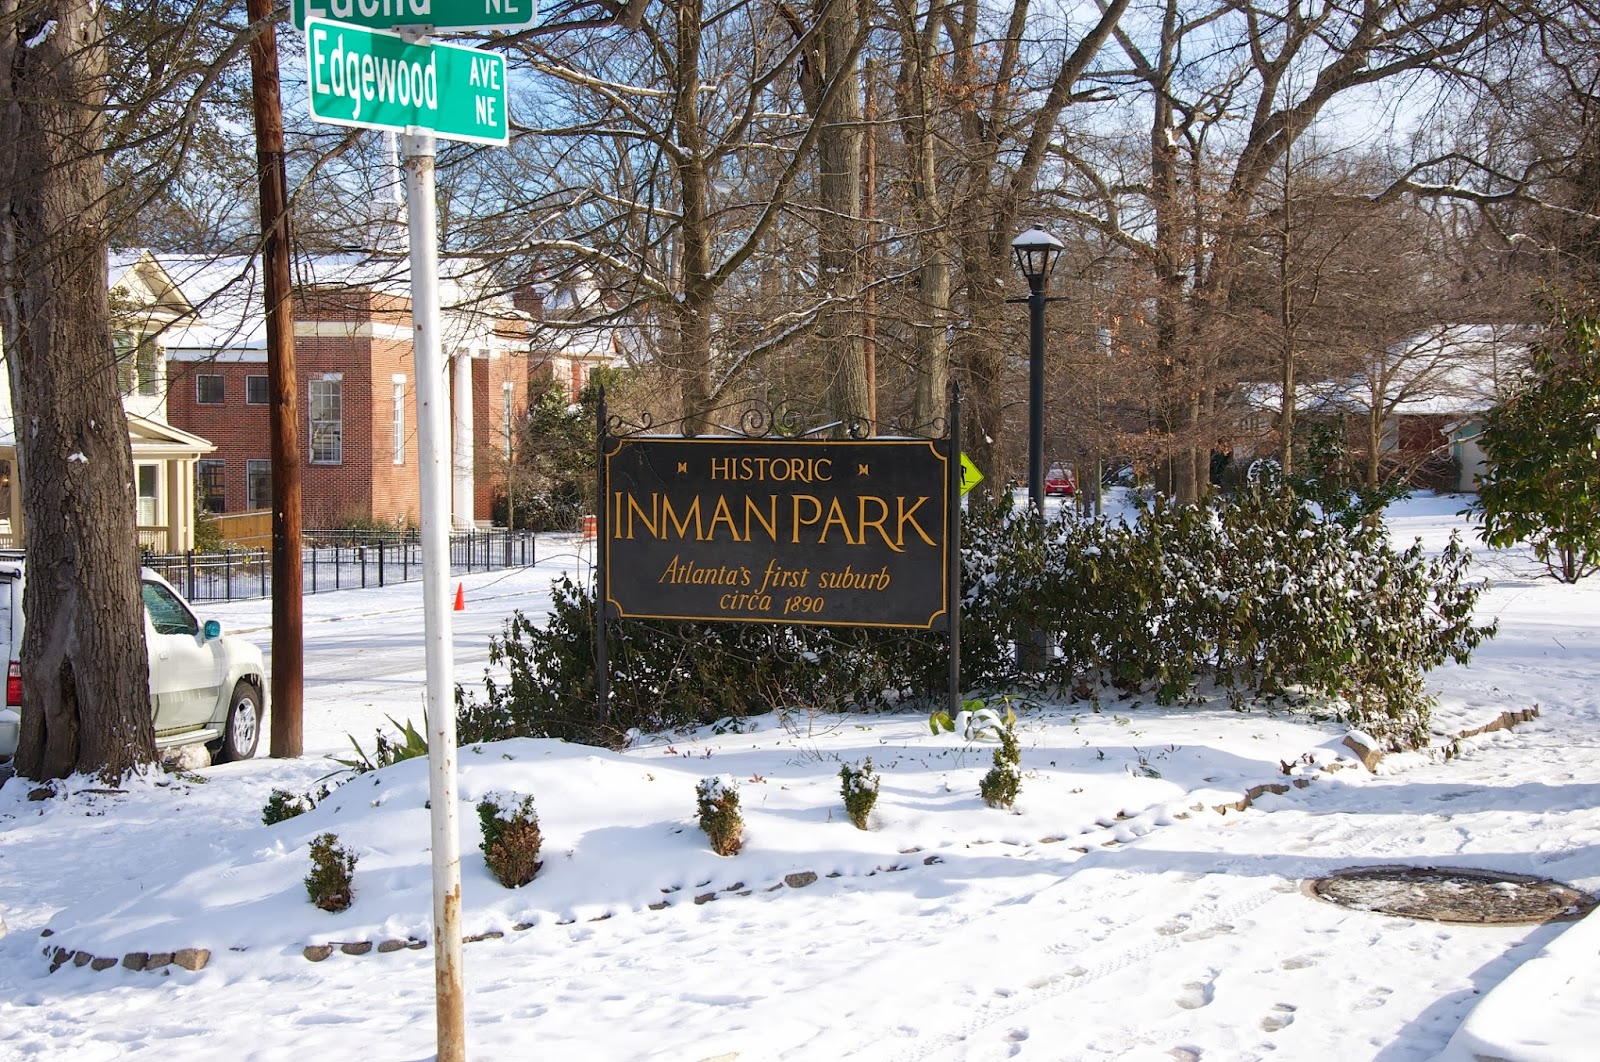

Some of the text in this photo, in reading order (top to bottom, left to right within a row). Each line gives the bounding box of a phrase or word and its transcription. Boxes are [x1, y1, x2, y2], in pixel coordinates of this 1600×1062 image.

[313, 29, 500, 120] Edgewood AVE
[476, 95, 497, 127] NE
[711, 457, 832, 483] HISTORIC
[613, 491, 938, 553] INMAN PARK
[659, 554, 891, 594] Atlanta's first suburb
[720, 590, 825, 615] circa 1890
